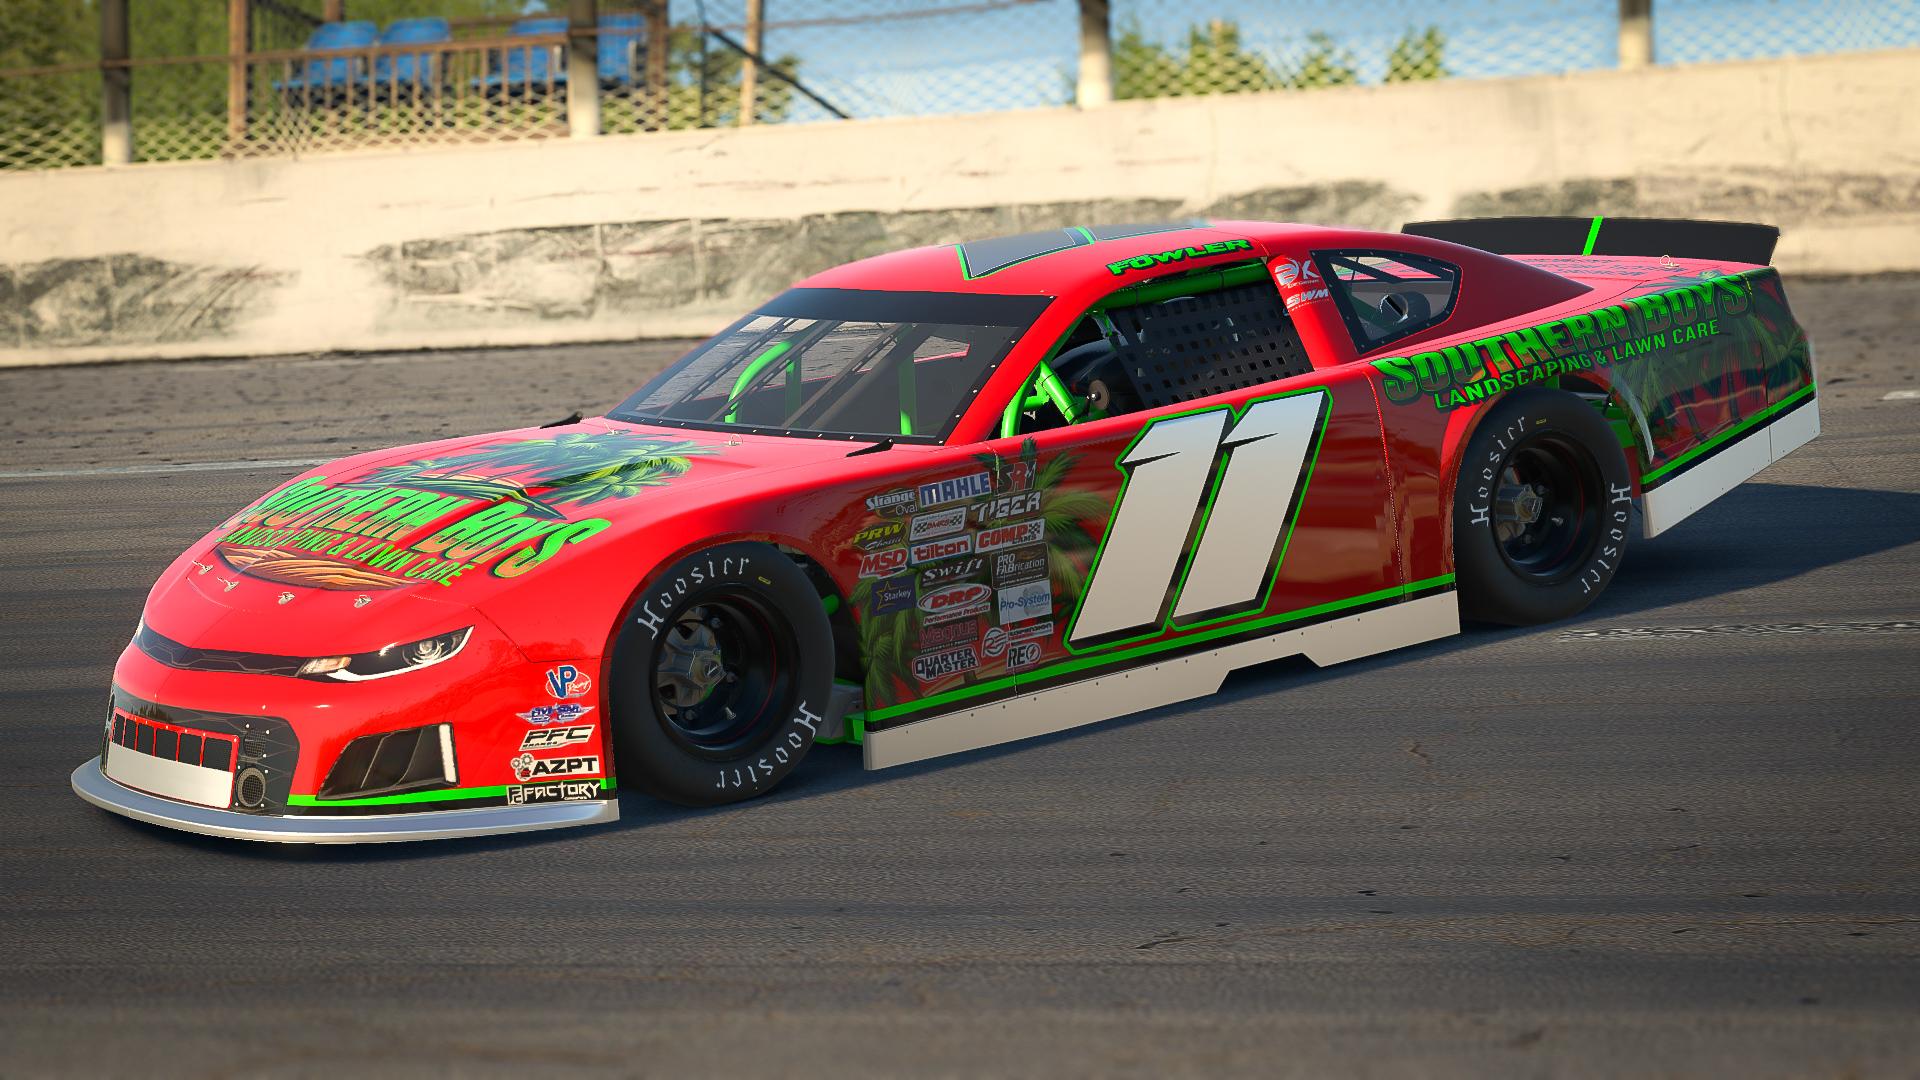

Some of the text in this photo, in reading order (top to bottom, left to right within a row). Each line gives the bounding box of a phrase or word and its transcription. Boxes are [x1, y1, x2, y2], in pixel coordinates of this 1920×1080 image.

[1106, 239, 1253, 275] FOWLER
[1287, 289, 1328, 308] SWM
[1369, 274, 1748, 400] SOUTHERN BOYS
[1434, 319, 1720, 409] LANDSCAPING & LAWN CARE
[866, 490, 915, 511] Strange
[921, 473, 990, 506] MAHLE
[896, 501, 918, 515] Oval
[970, 492, 1040, 522] TIGER
[1066, 387, 1329, 648] 11
[221, 475, 612, 578] SOUTHERN BOYS
[853, 523, 903, 543] PRW
[979, 524, 1029, 548] COMP
[326, 535, 358, 555] &
[343, 540, 416, 572] LAWN
[404, 557, 475, 586] CARE
[861, 549, 907, 574] MSD
[914, 540, 968, 560] tilton
[998, 553, 1015, 564] PRO
[884, 589, 911, 601] Starkey
[930, 586, 982, 609] DRP
[915, 649, 973, 674] QUARTER
[926, 658, 976, 679] MASTER
[546, 665, 577, 698] VP
[525, 727, 592, 743] PFC
[532, 757, 597, 776] AZPT
[523, 782, 600, 801] FACTORY
